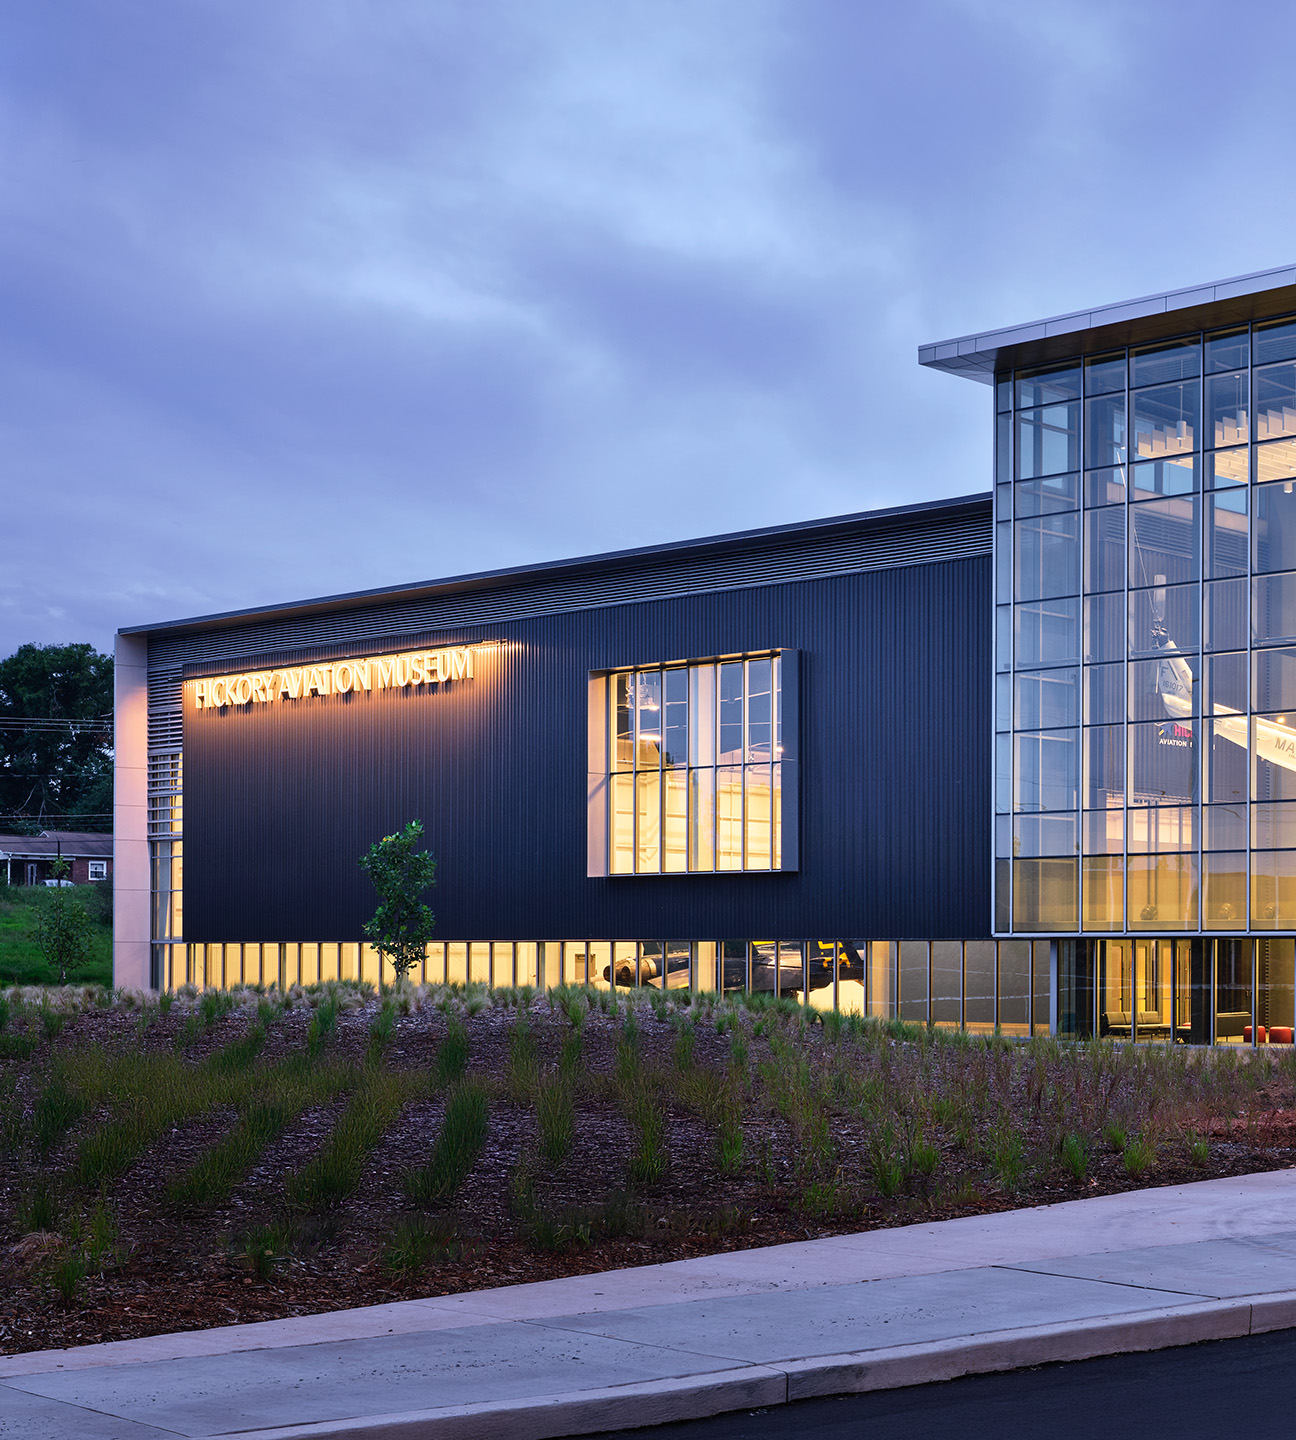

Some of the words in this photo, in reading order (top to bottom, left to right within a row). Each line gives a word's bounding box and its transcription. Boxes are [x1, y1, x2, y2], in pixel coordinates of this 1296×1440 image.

[195, 674, 276, 709] HICKORY
[277, 662, 372, 700] AVIATION
[377, 648, 474, 689] MUSEUM
[1162, 680, 1184, 692] 161017
[1159, 738, 1187, 748] AVIATION
